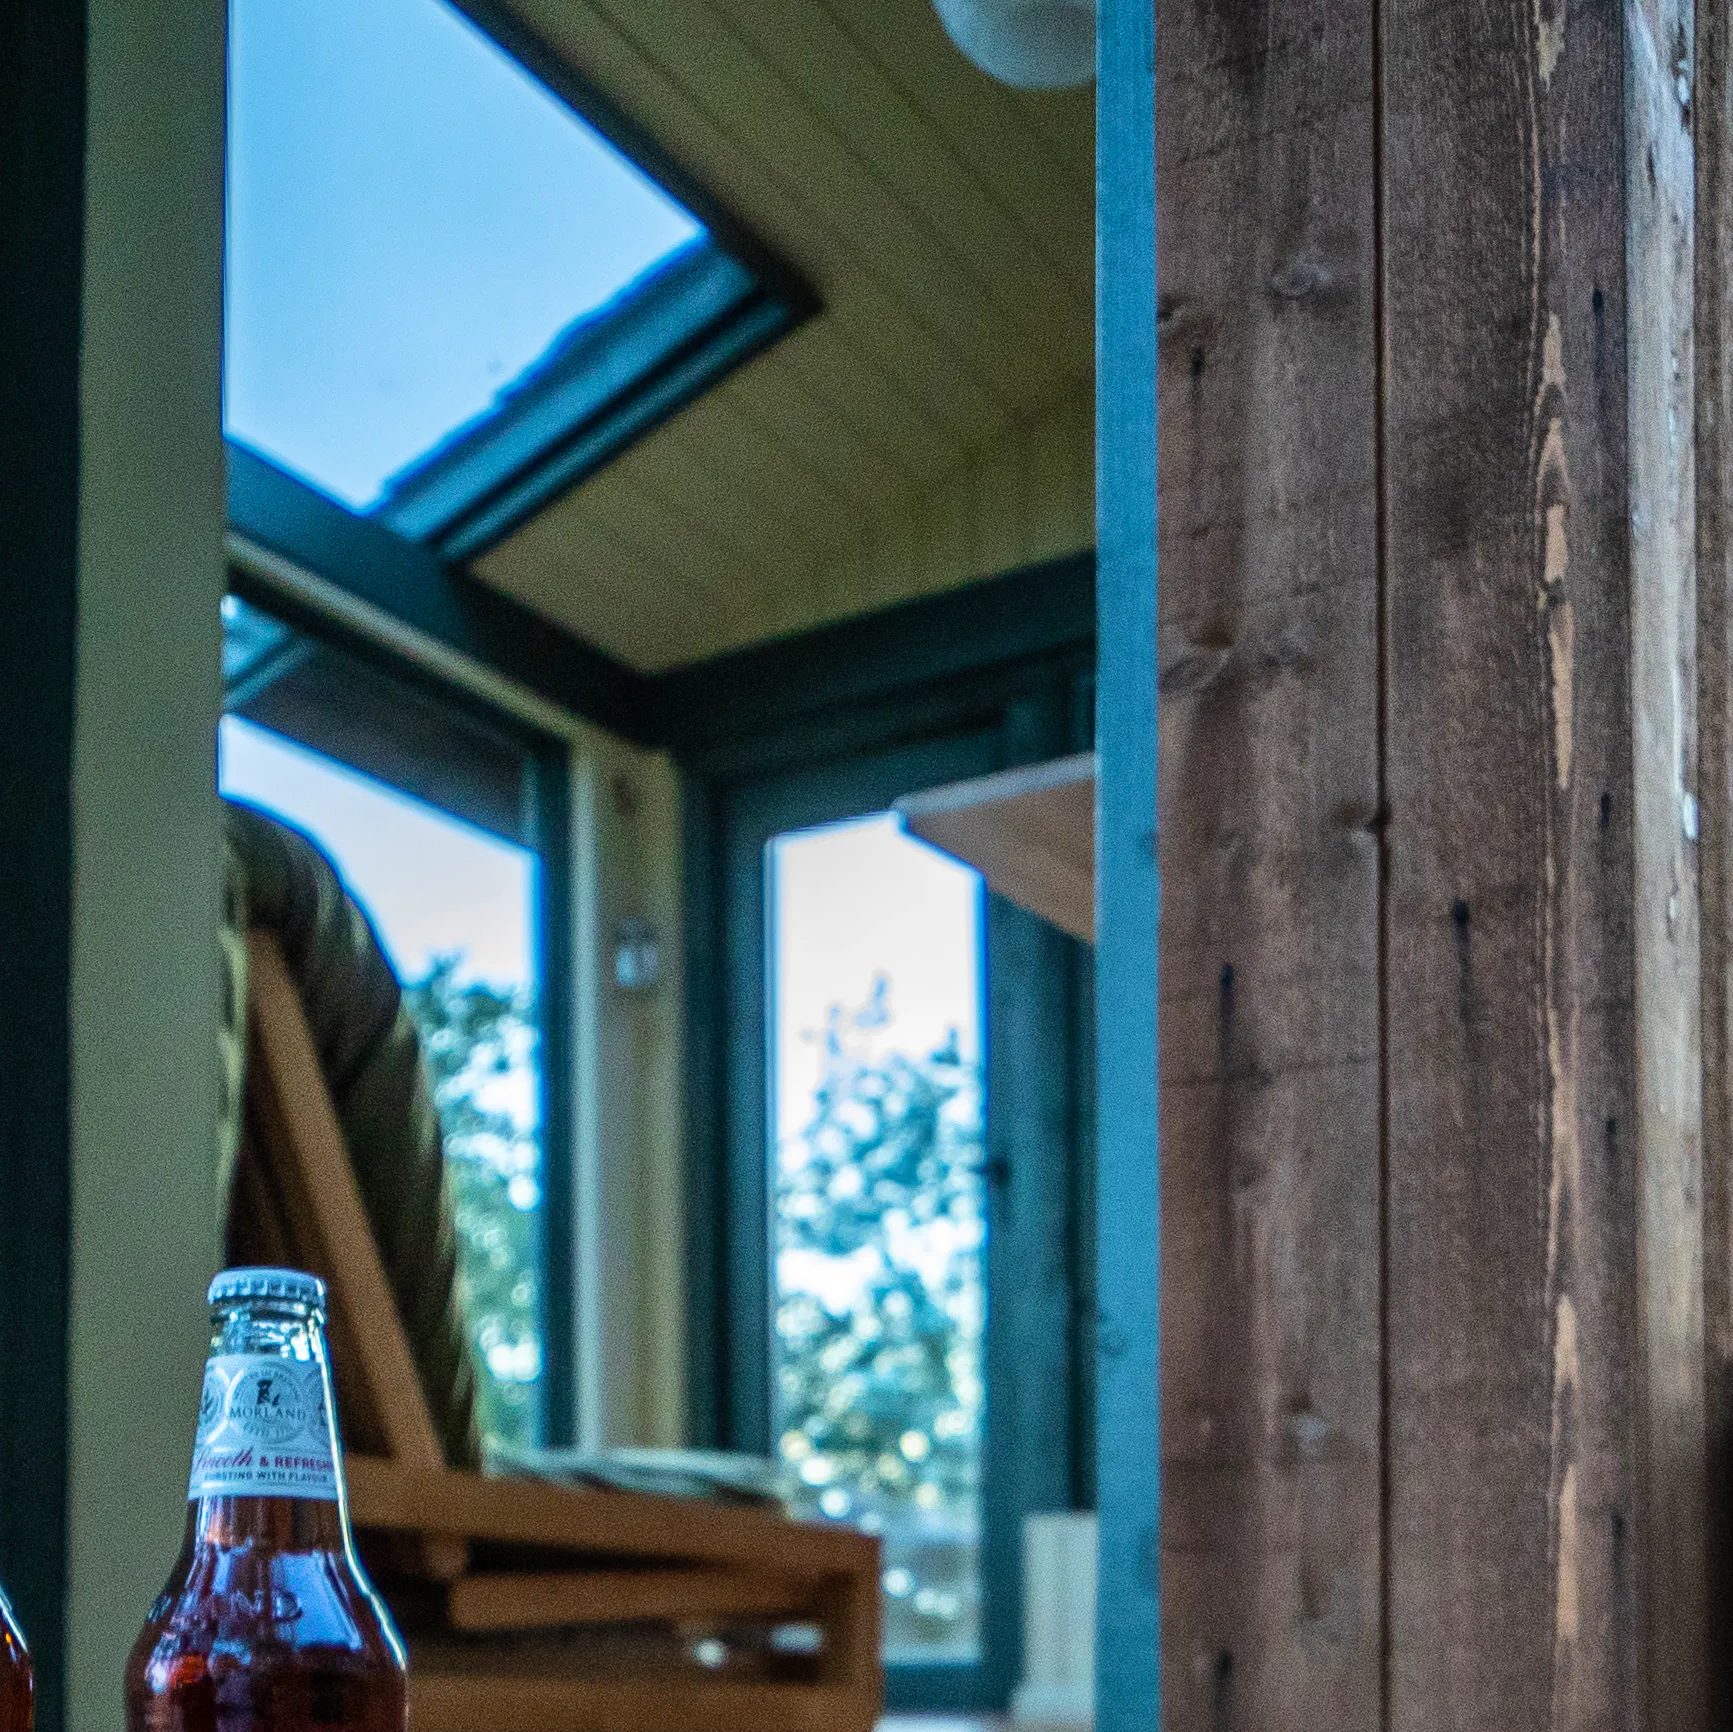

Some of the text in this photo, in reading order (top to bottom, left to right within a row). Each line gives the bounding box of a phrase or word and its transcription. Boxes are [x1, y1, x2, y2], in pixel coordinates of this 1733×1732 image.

[230, 1406, 306, 1421] MORLAND
[259, 1456, 269, 1467] &
[256, 1471, 285, 1481] WITH
